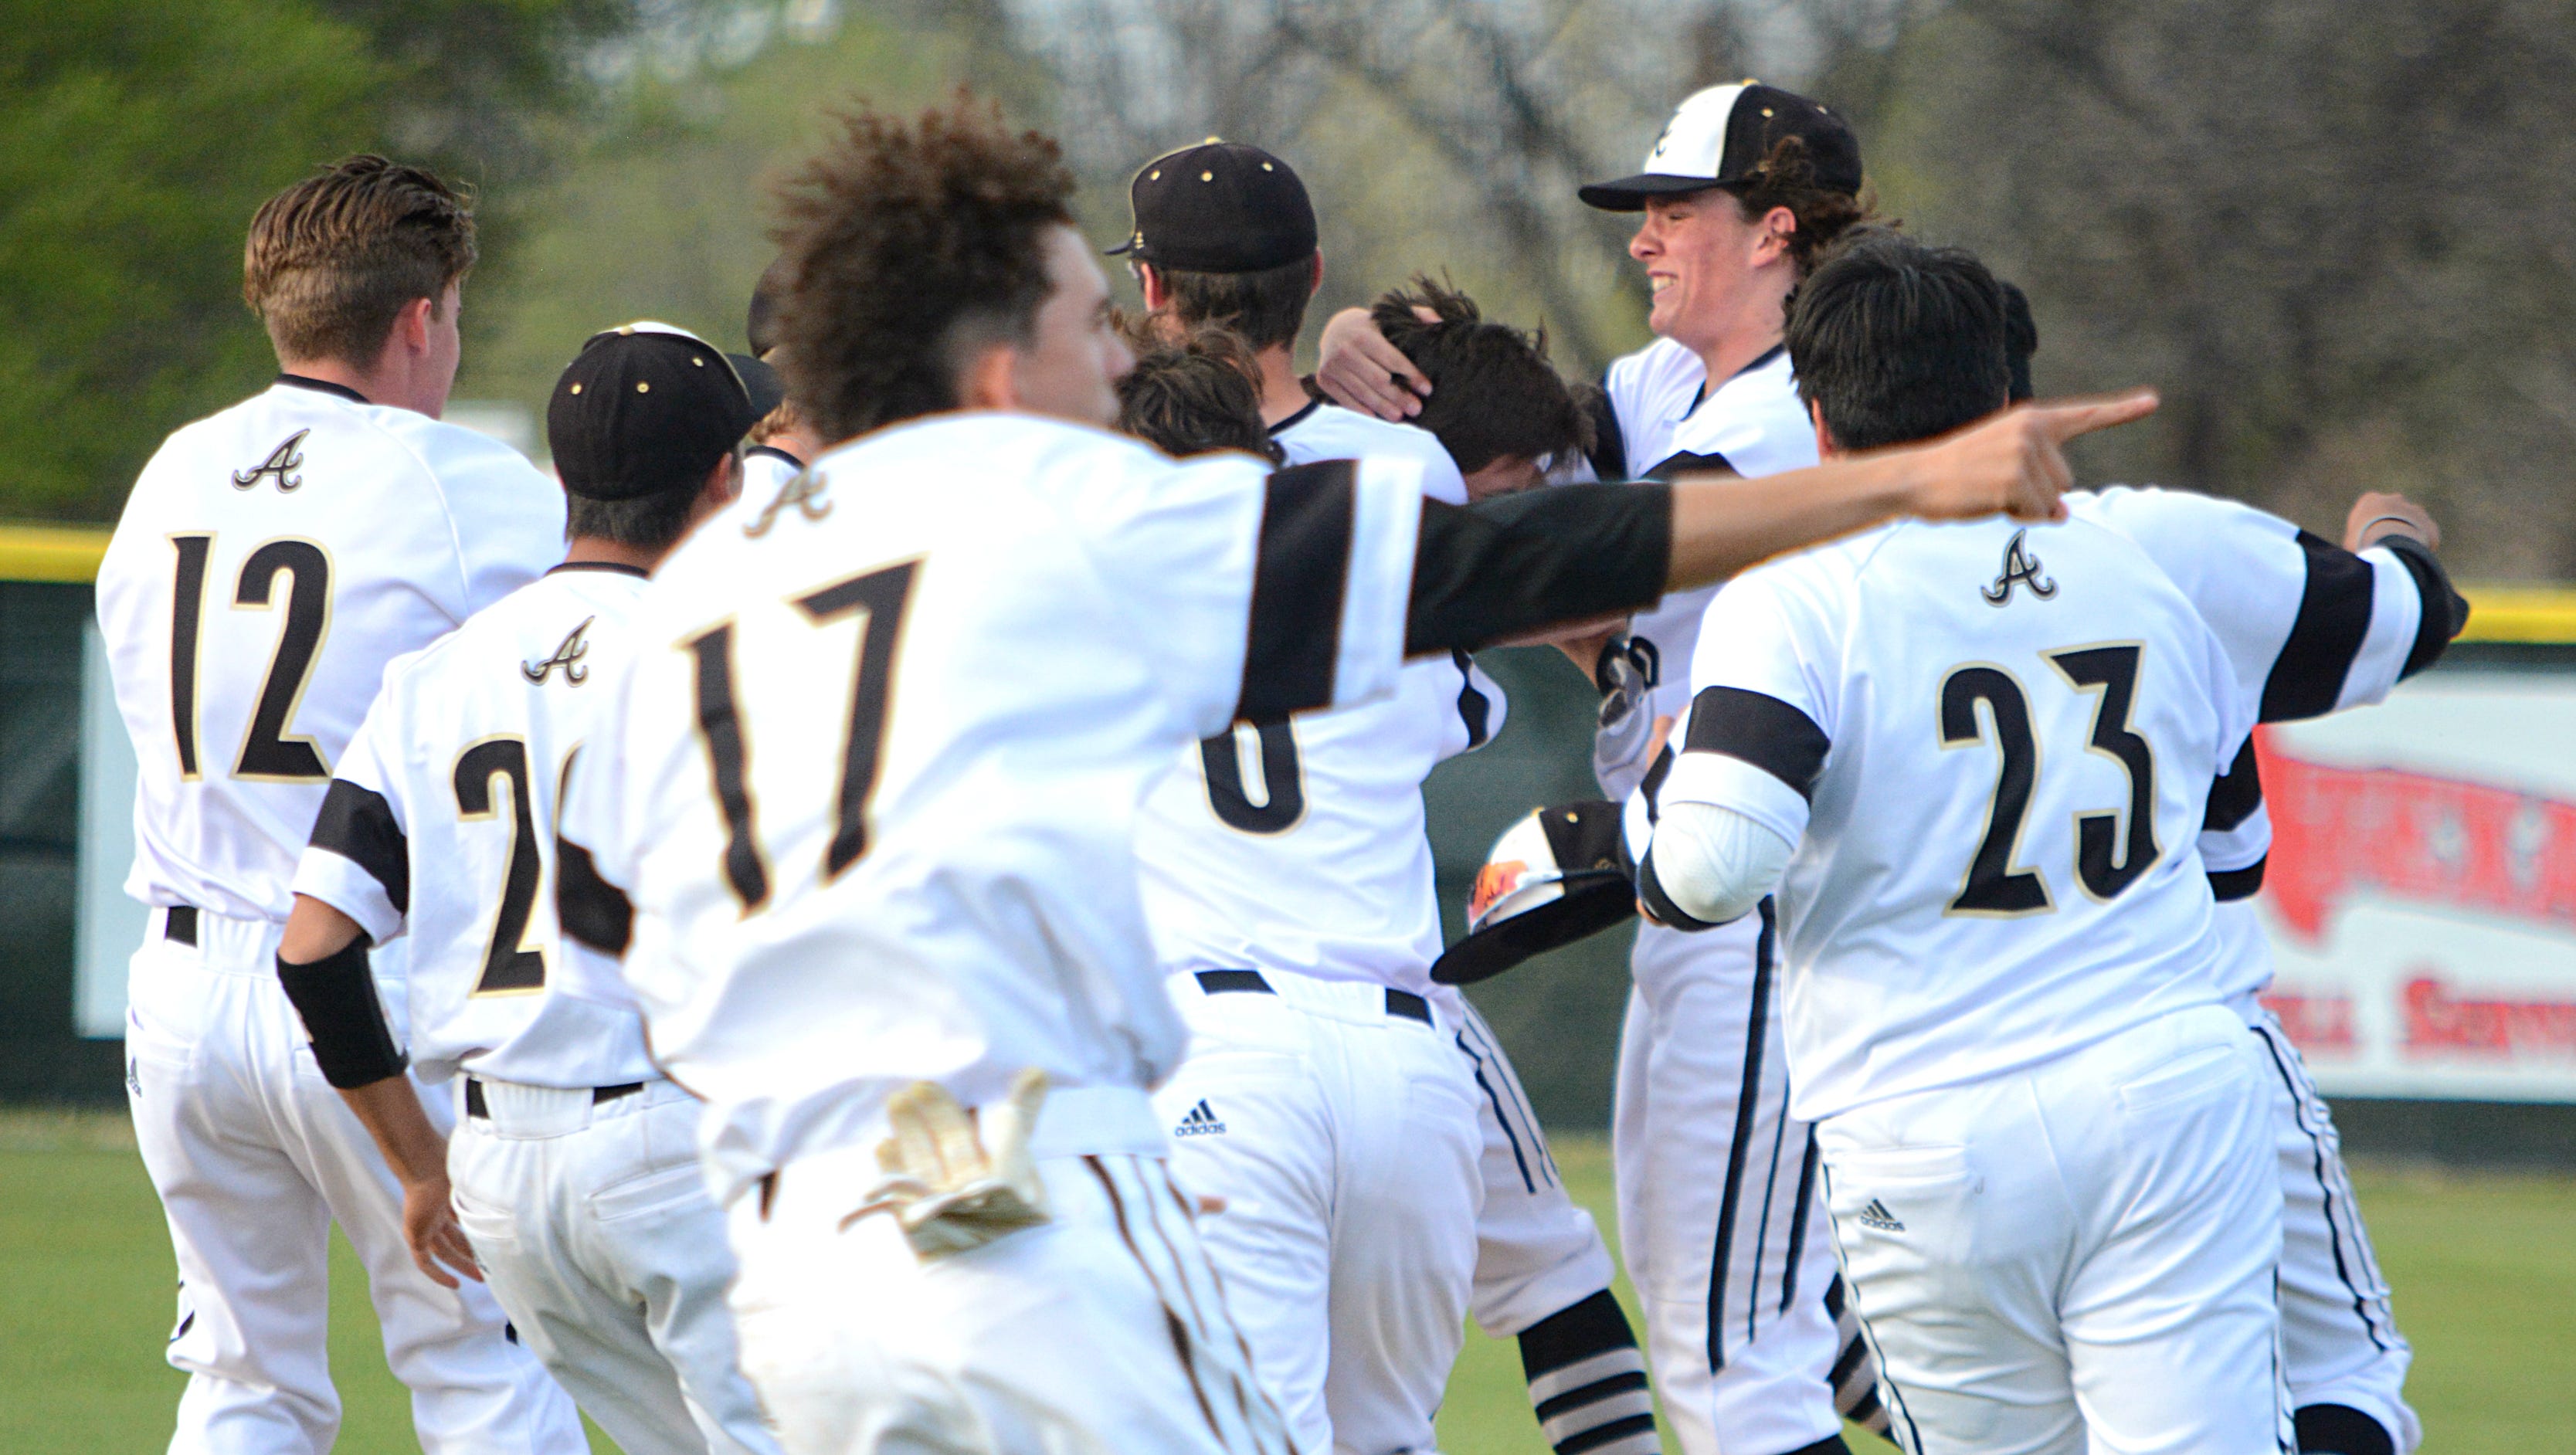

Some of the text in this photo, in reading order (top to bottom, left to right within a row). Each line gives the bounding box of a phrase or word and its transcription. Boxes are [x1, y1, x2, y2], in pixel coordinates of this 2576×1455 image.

[165, 530, 336, 785] 12
[672, 550, 929, 923] 17
[1935, 639, 2165, 920] 23
[448, 731, 585, 999] 2
[1175, 1122, 1227, 1137] adidas
[1860, 1215, 1906, 1232] adidas
